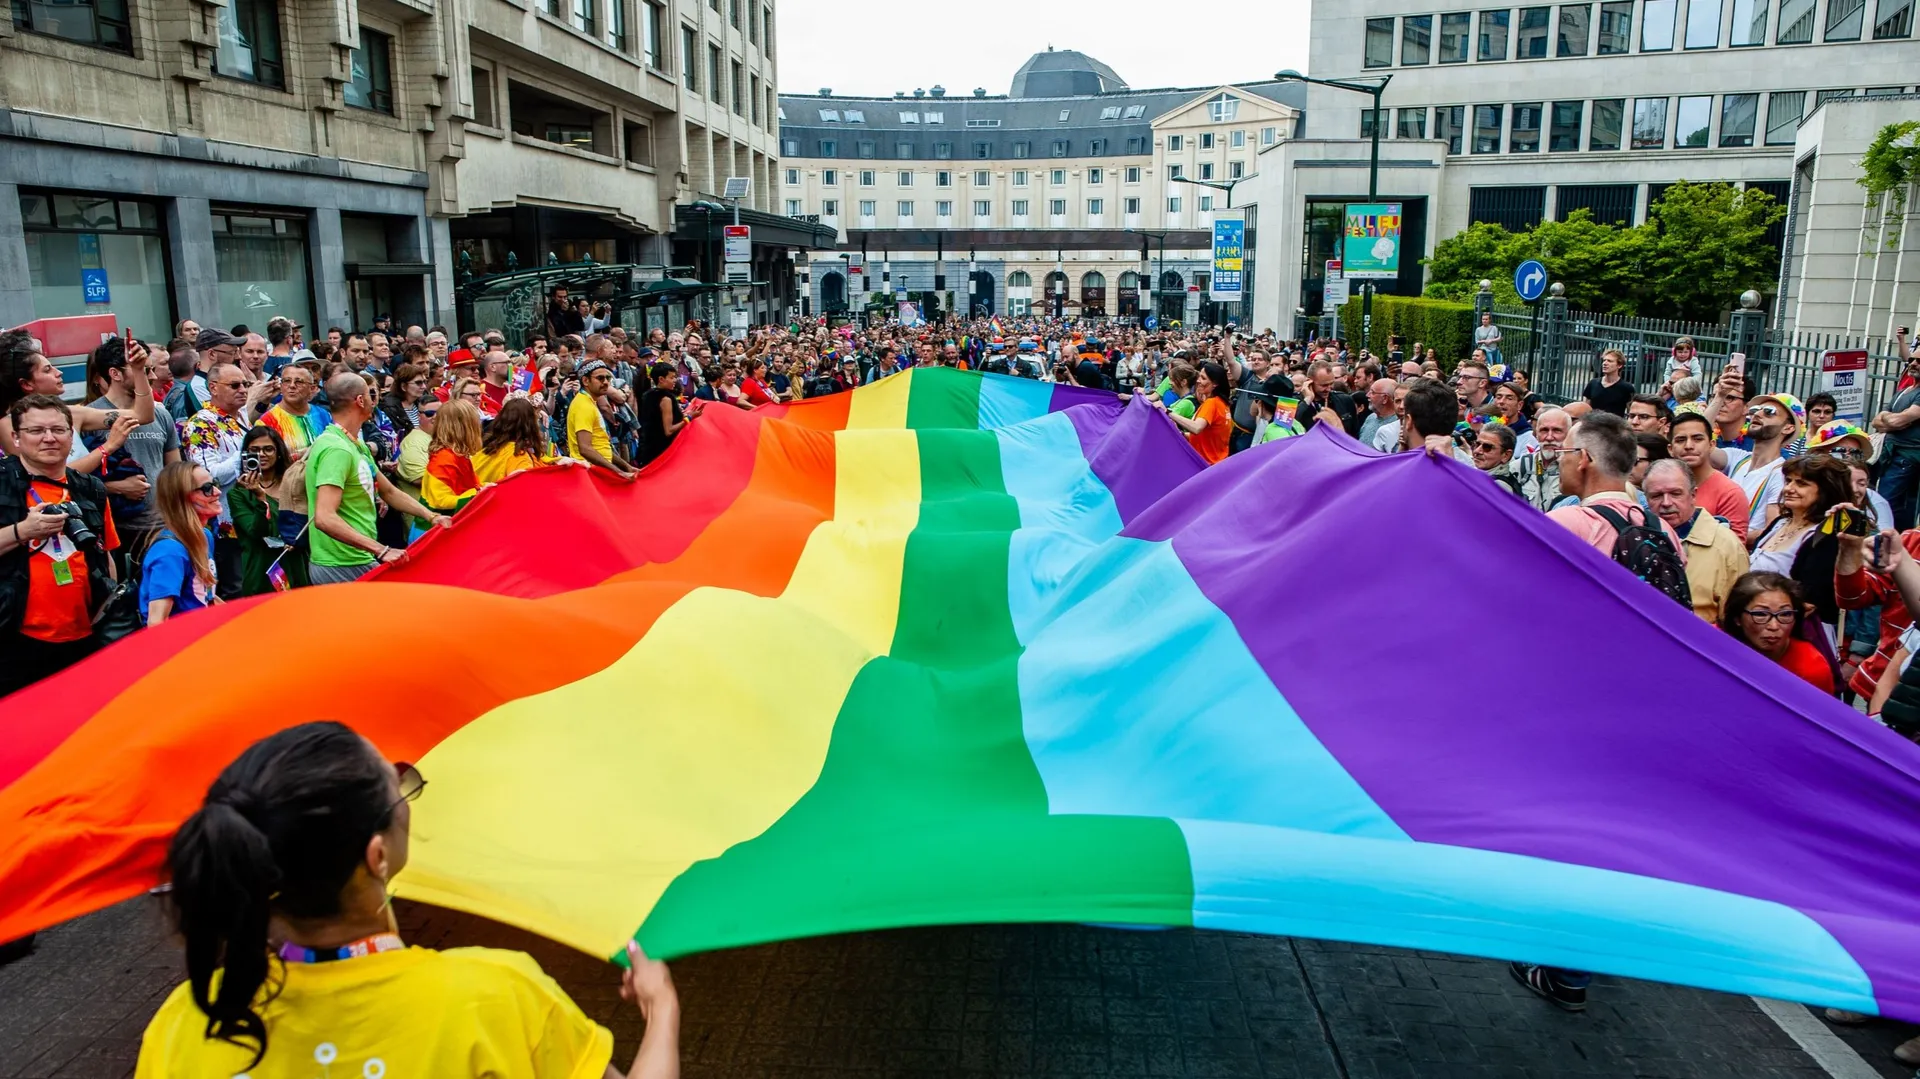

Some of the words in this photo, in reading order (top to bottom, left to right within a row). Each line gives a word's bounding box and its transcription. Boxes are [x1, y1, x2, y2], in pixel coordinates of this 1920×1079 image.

[1345, 215, 1400, 229] MILIEU
[87, 286, 106, 296] SLFP
[1825, 355, 1836, 367] INFO
